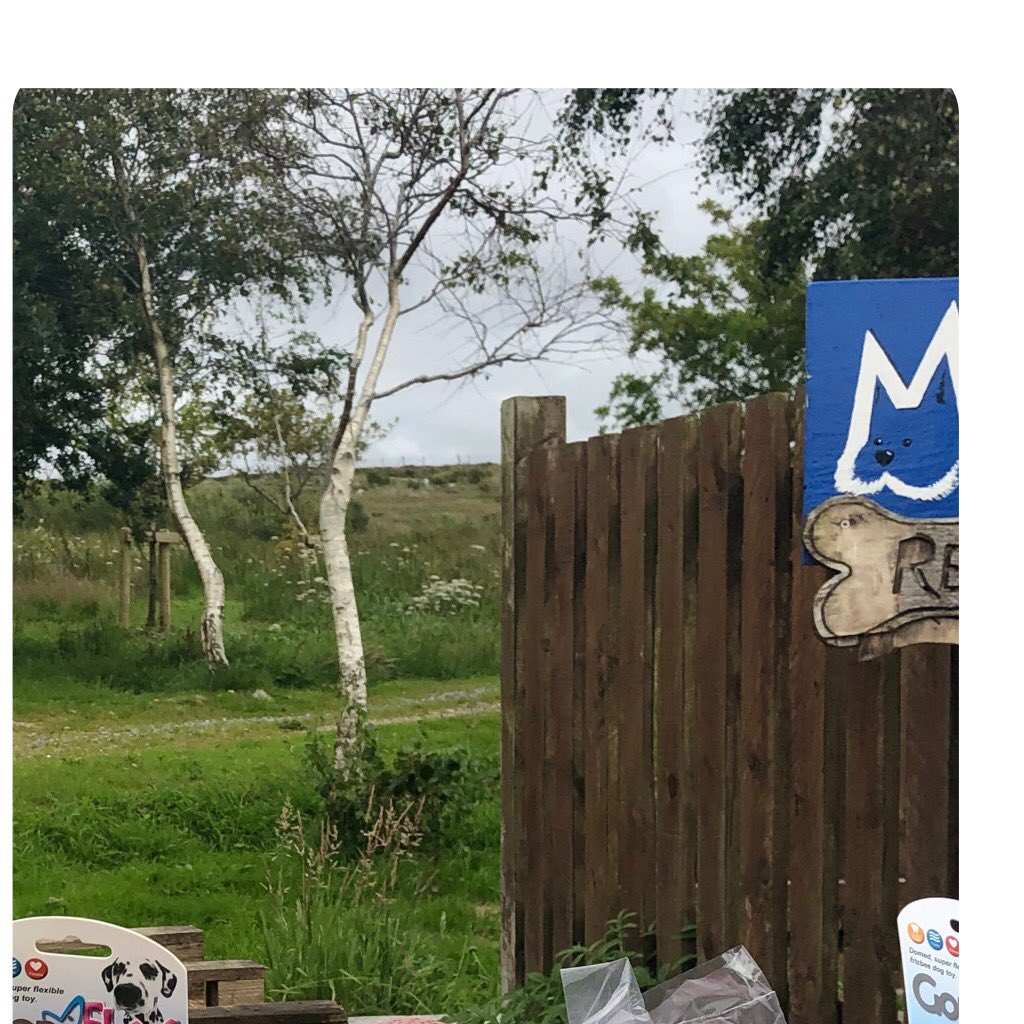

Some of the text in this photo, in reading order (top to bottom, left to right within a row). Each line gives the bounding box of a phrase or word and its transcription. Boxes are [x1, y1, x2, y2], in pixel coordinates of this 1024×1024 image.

[932, 965, 945, 975] dog
[33, 986, 65, 995] flexible
[912, 973, 959, 1021] Go
